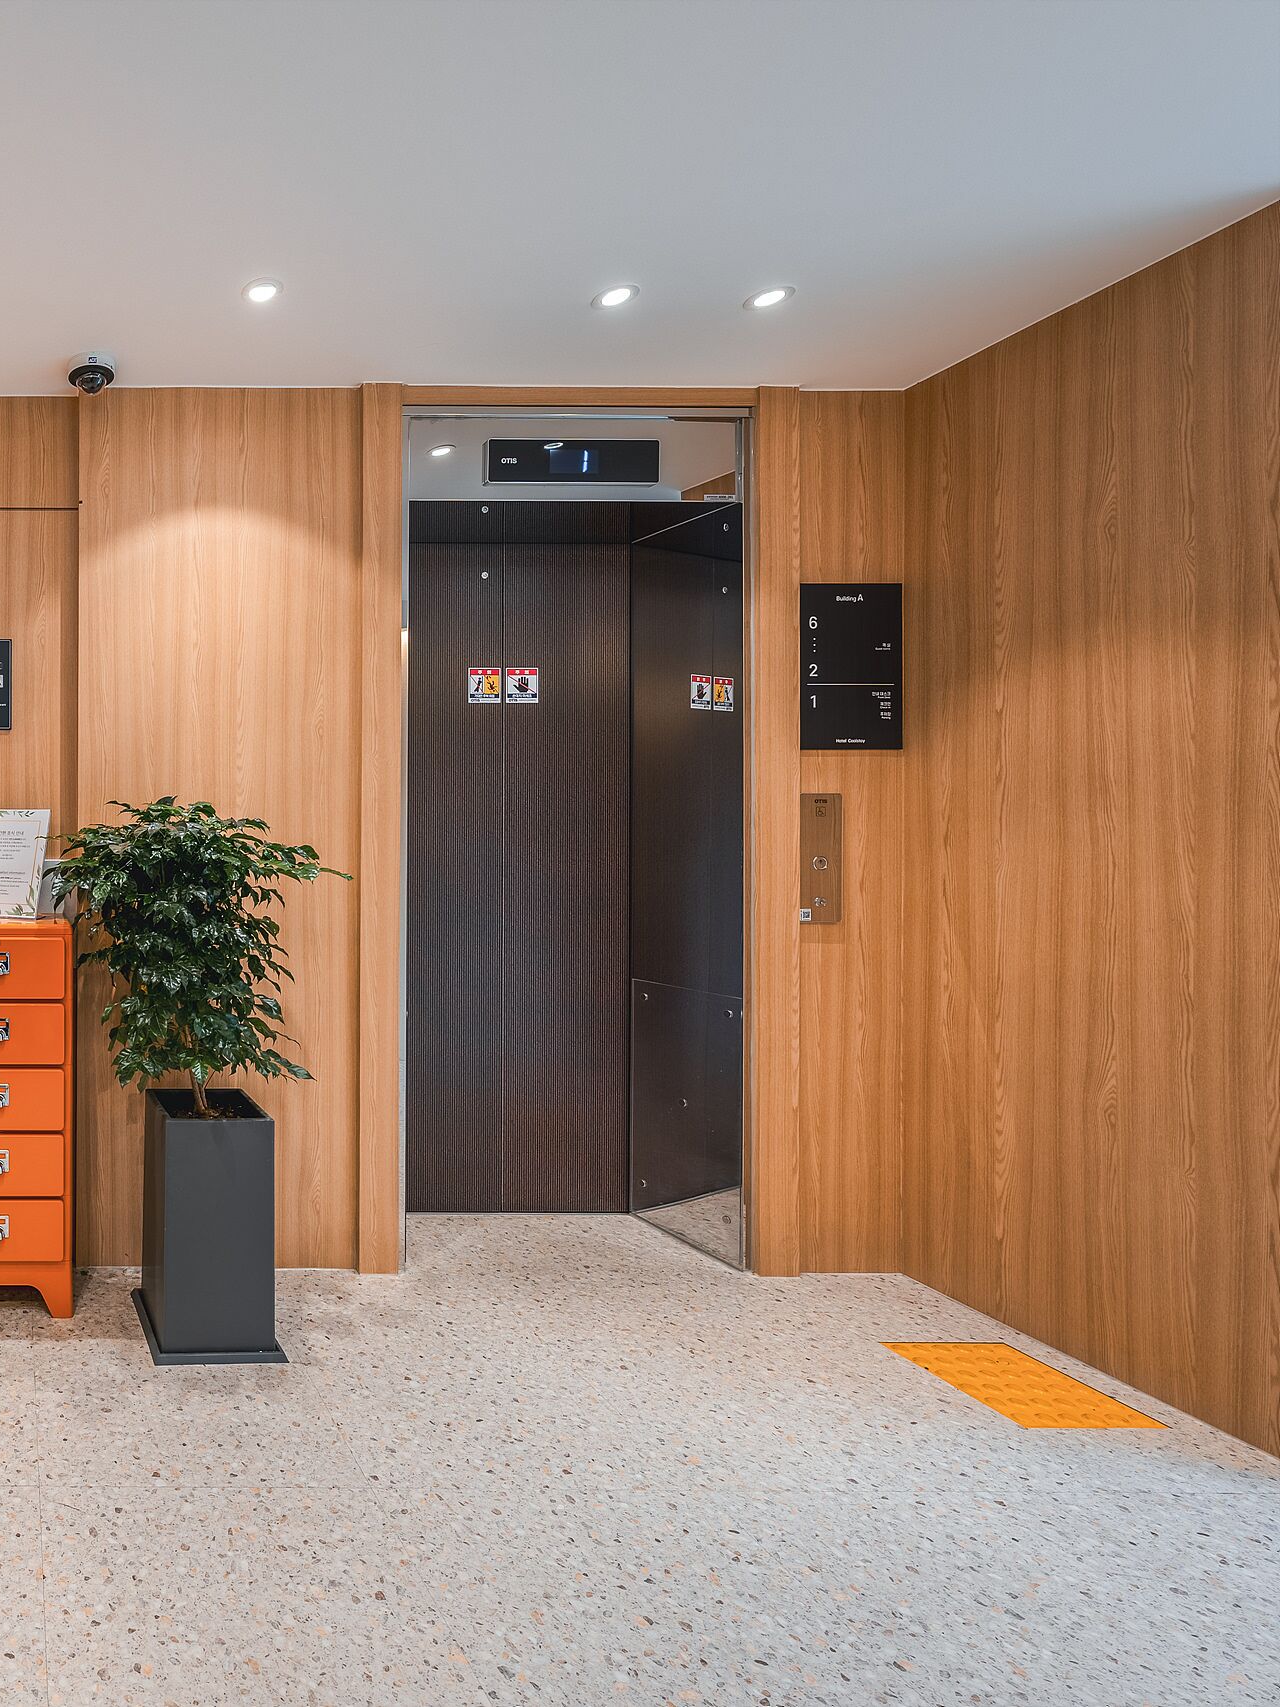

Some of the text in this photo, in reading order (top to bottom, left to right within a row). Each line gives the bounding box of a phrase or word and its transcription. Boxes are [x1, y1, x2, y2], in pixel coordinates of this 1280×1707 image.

[835, 593, 864, 603] Building A
[808, 615, 818, 630] 6
[808, 663, 819, 677] 2
[810, 695, 817, 709] 1
